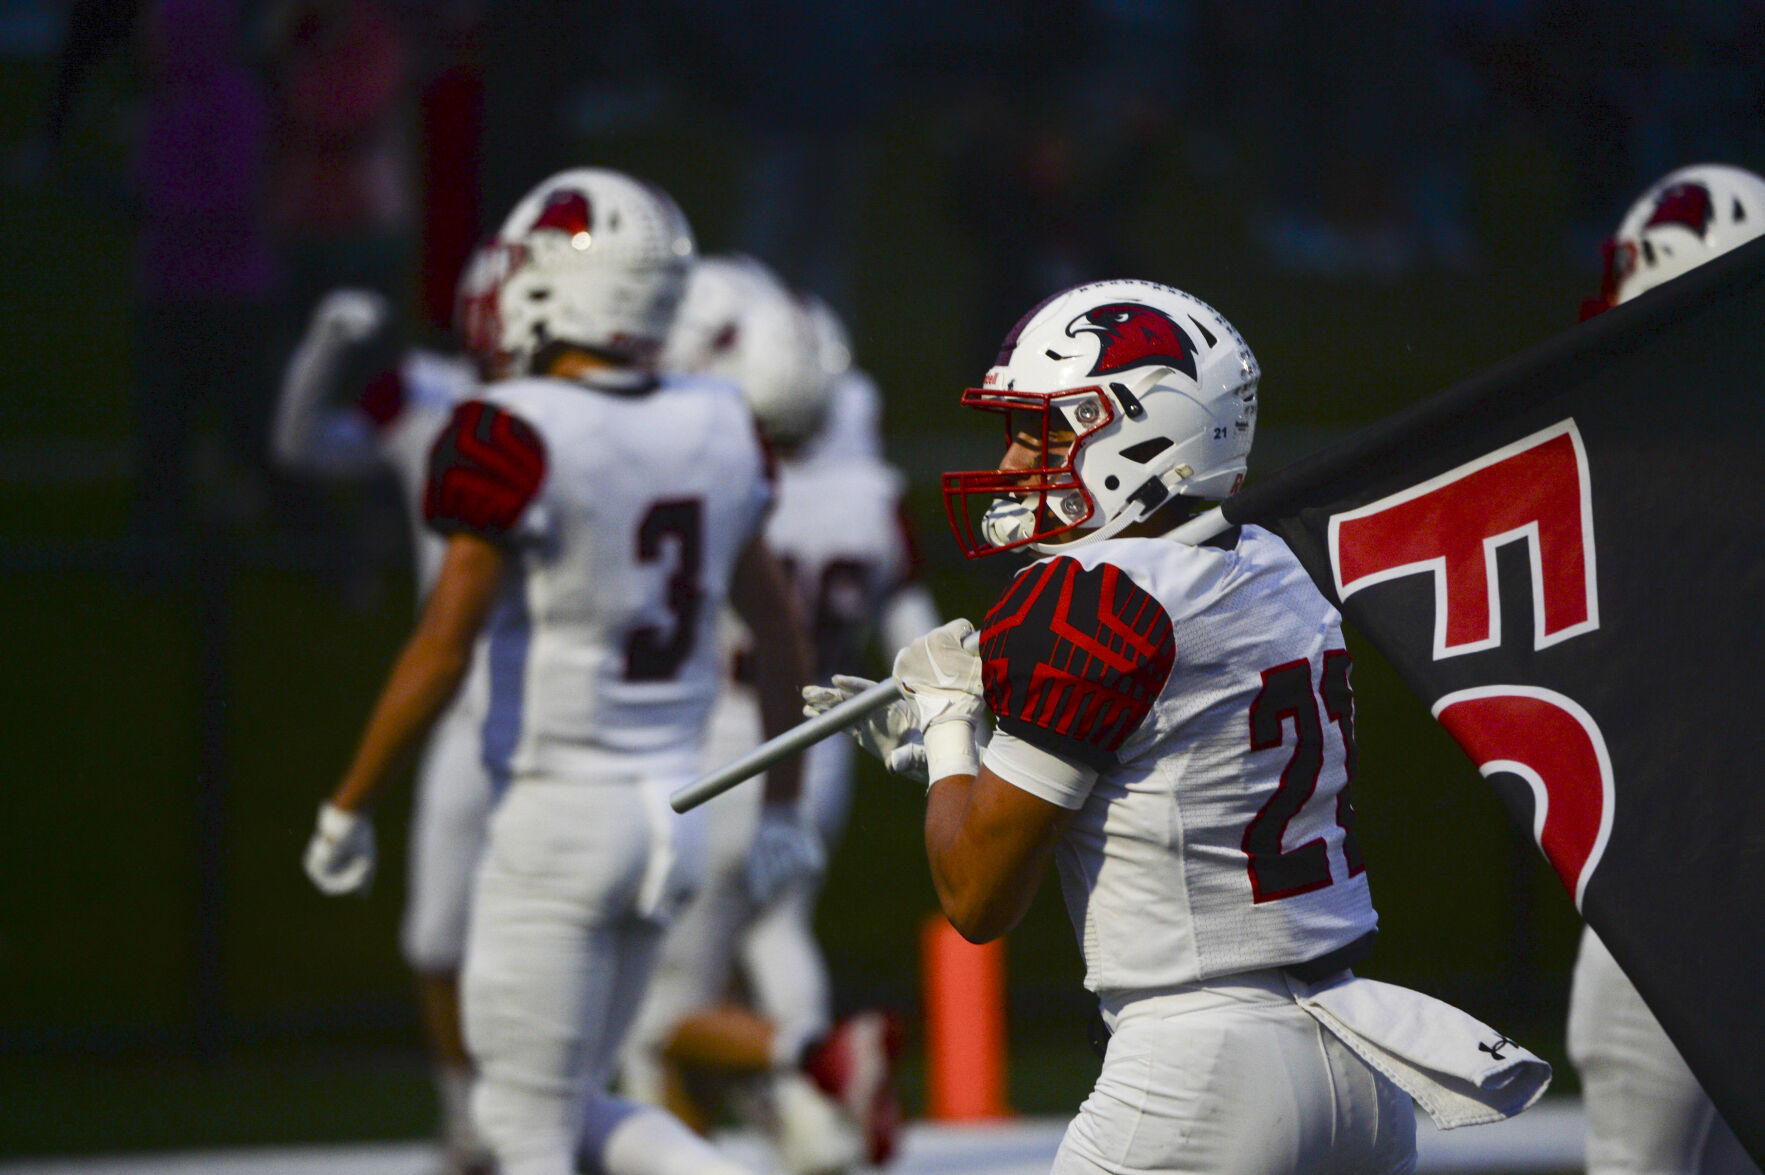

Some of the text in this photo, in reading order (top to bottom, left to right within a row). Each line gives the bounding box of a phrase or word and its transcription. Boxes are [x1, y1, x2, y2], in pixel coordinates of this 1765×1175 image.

[1213, 427, 1227, 439] 21
[623, 497, 706, 683] 3
[1242, 649, 1366, 904] 21
